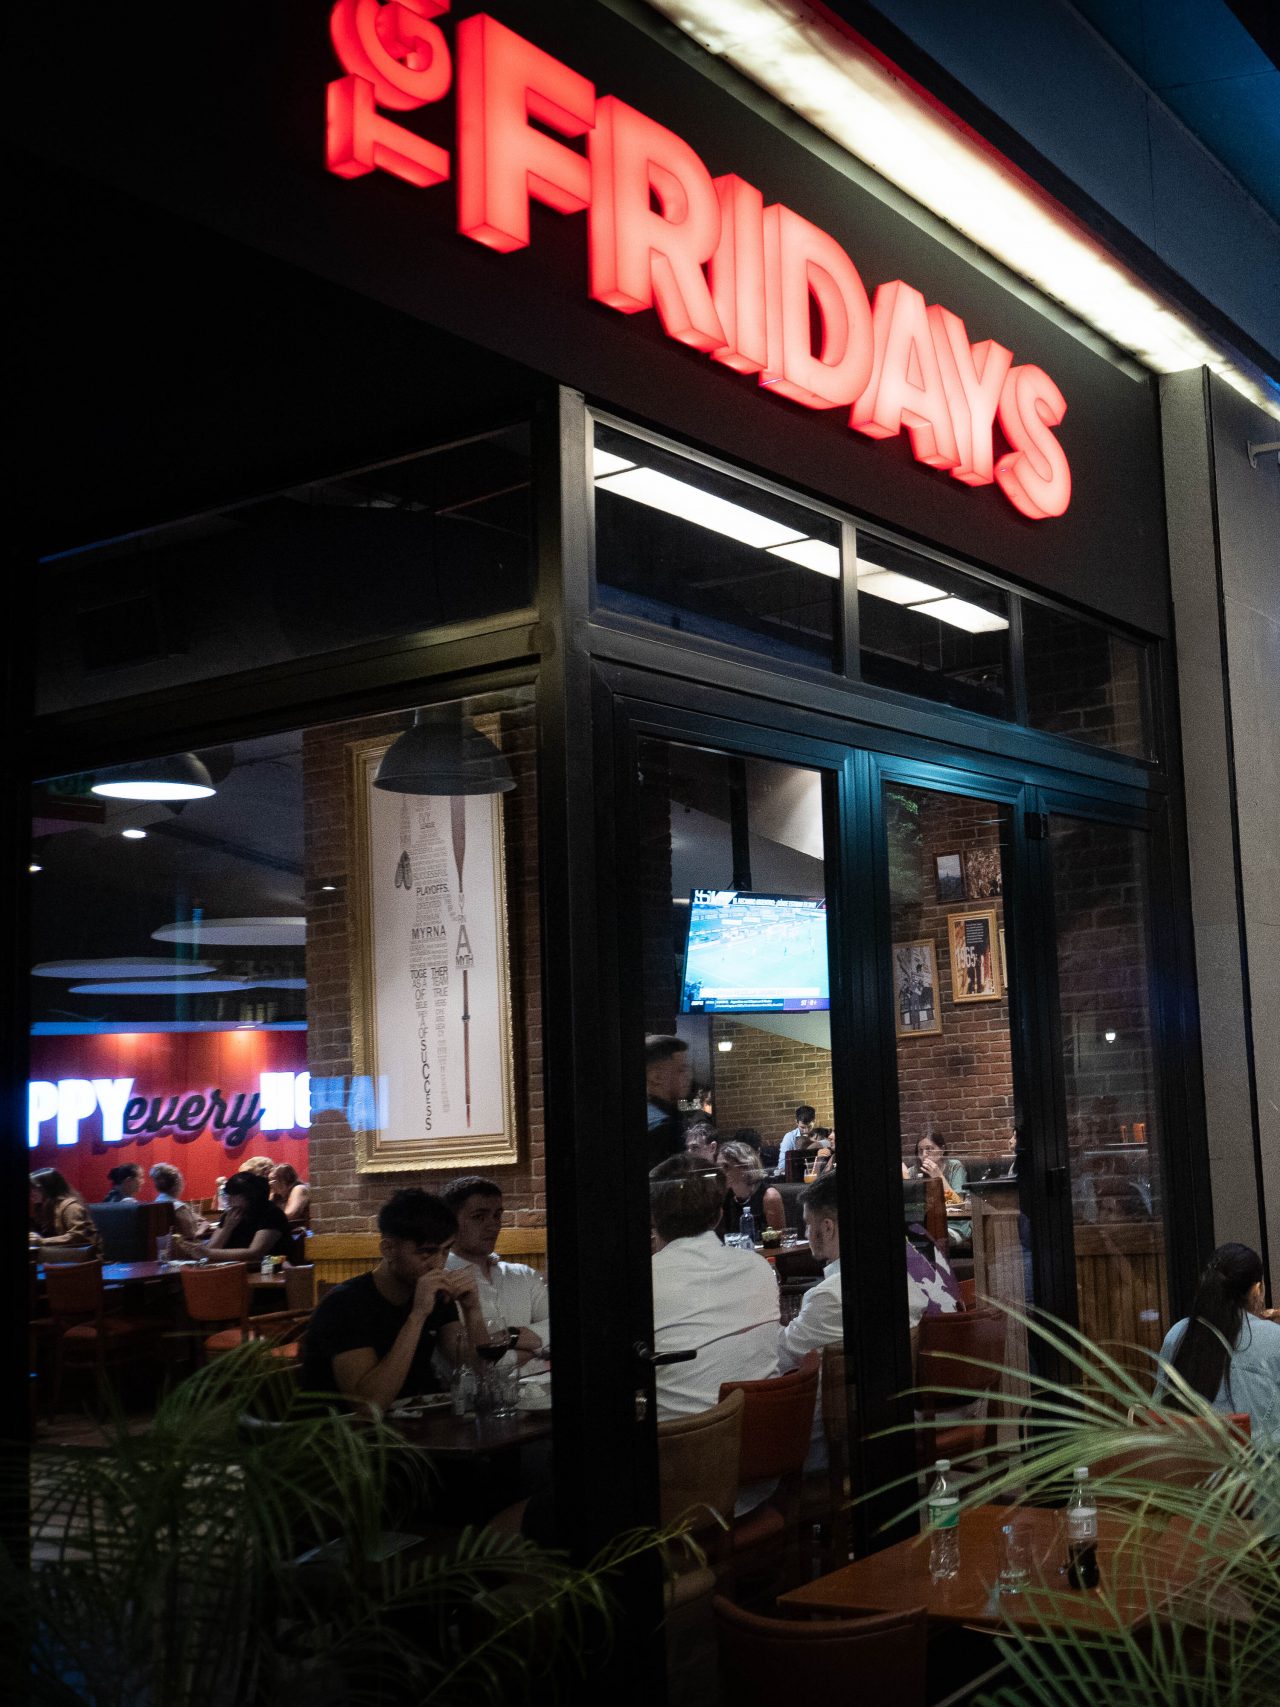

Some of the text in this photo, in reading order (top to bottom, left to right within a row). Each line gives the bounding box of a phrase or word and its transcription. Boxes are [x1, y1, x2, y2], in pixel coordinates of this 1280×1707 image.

[326, 0, 451, 188] TG
[456, 12, 1072, 520] FRIDAYS
[411, 924, 447, 940] MYRNA
[955, 946, 976, 969] 1965
[122, 1088, 266, 1147] every
